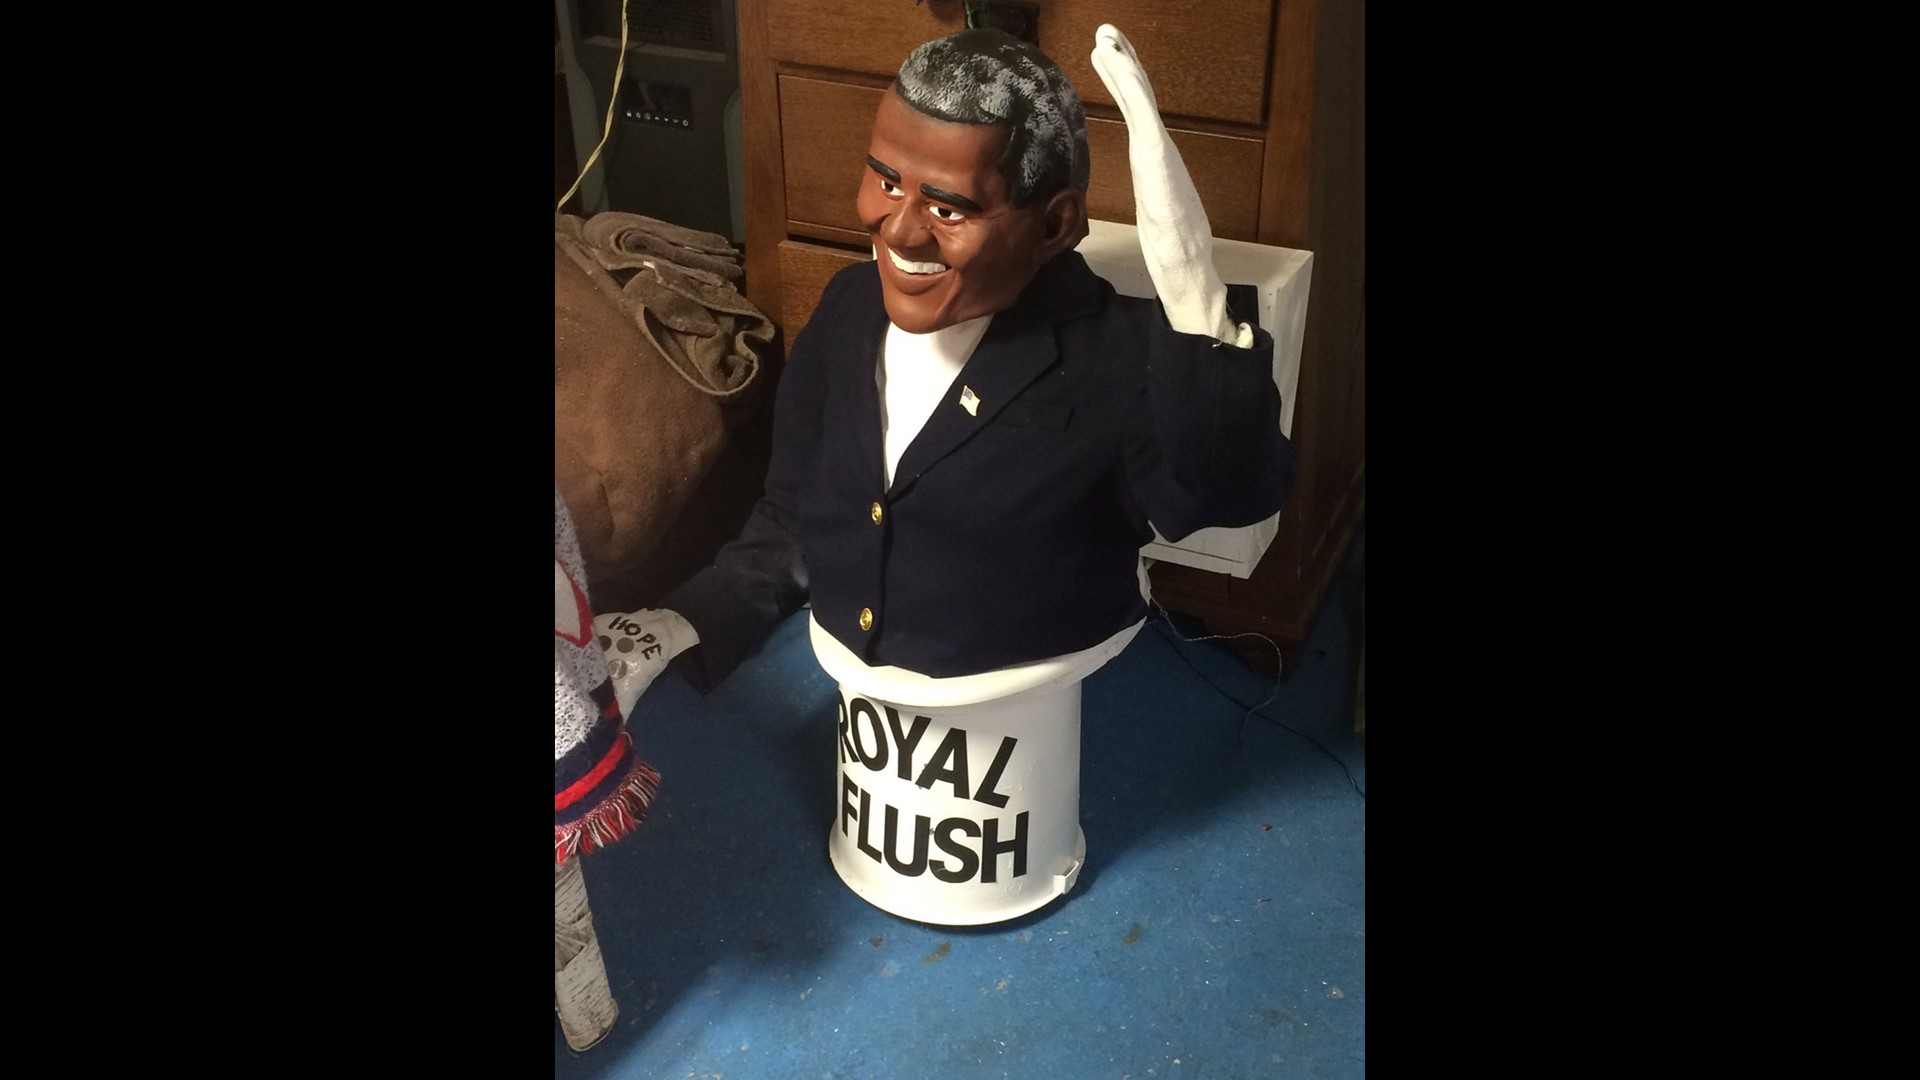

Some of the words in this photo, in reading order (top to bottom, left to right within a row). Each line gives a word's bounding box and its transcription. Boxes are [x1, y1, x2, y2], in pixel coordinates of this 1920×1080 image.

[608, 616, 662, 660] HOPE
[838, 690, 1018, 809] ROYAL
[842, 770, 1030, 884] FLUSH
